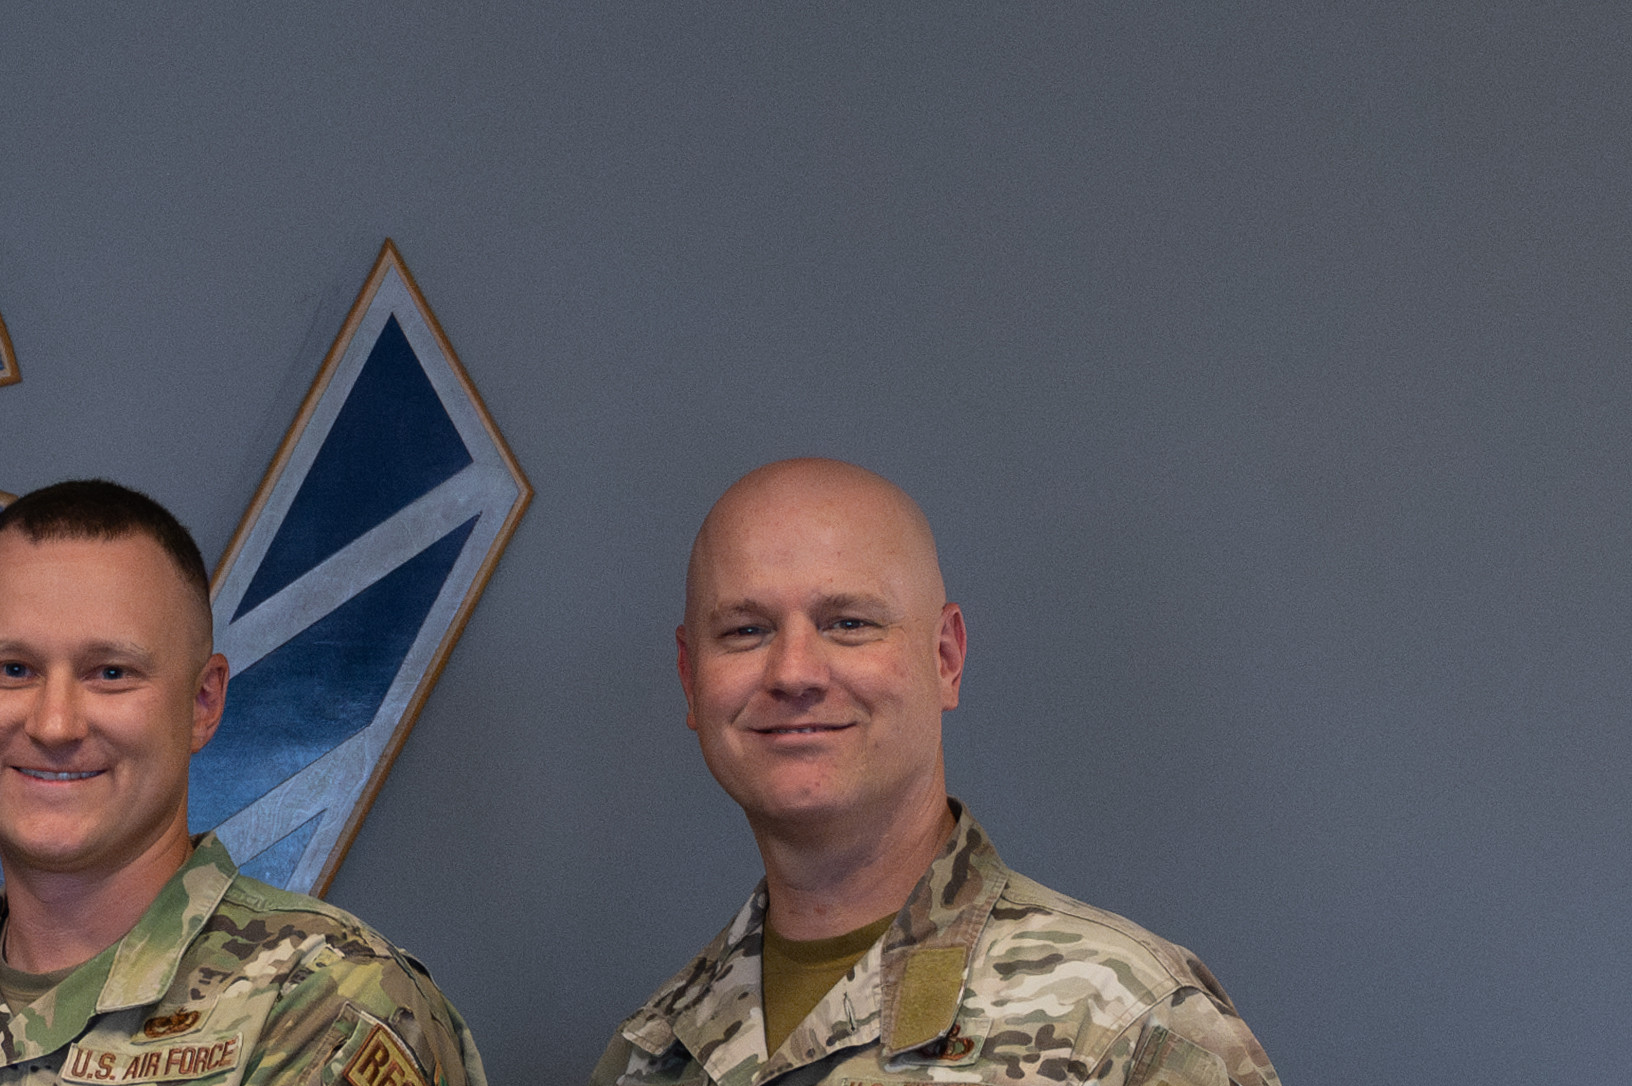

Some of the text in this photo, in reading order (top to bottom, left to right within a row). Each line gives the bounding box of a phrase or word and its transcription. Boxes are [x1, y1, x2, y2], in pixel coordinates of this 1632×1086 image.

[70, 1038, 239, 1081] U.S. AIR FORCE
